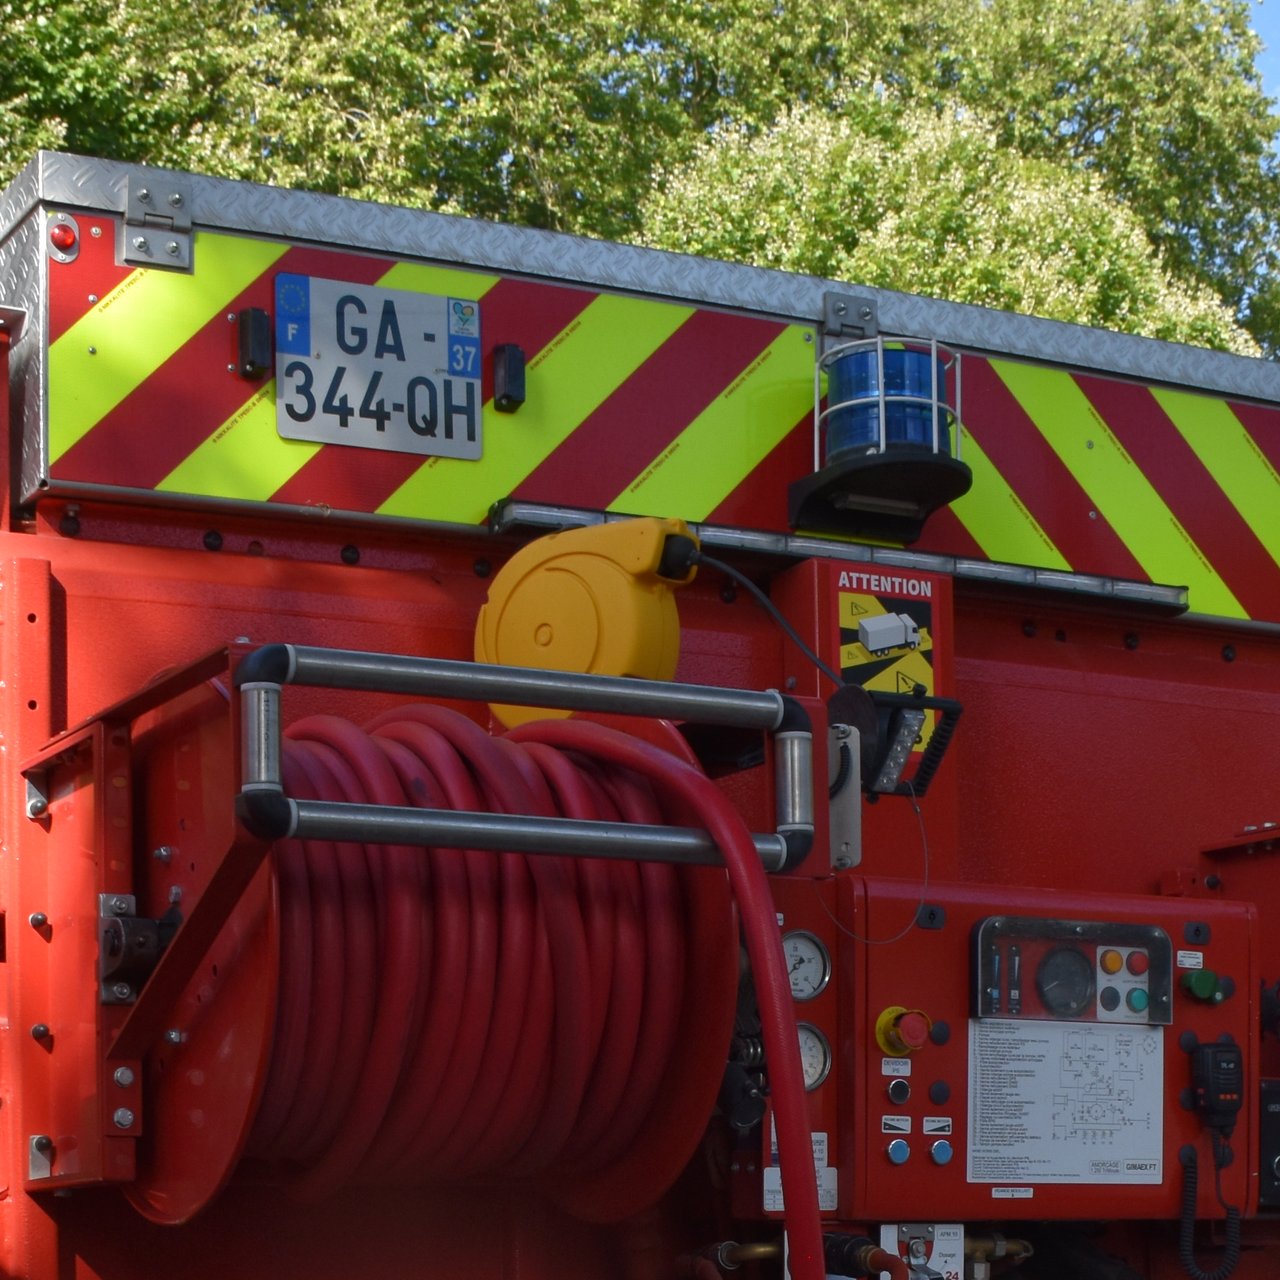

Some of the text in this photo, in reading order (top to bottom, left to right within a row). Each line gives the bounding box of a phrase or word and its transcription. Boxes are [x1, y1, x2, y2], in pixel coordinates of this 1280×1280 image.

[287, 323, 298, 341] F
[452, 344, 477, 371] 37
[284, 361, 476, 442] 344-QH
[838, 570, 932, 597] ATTENTION
[945, 1271, 959, 1280] 24
